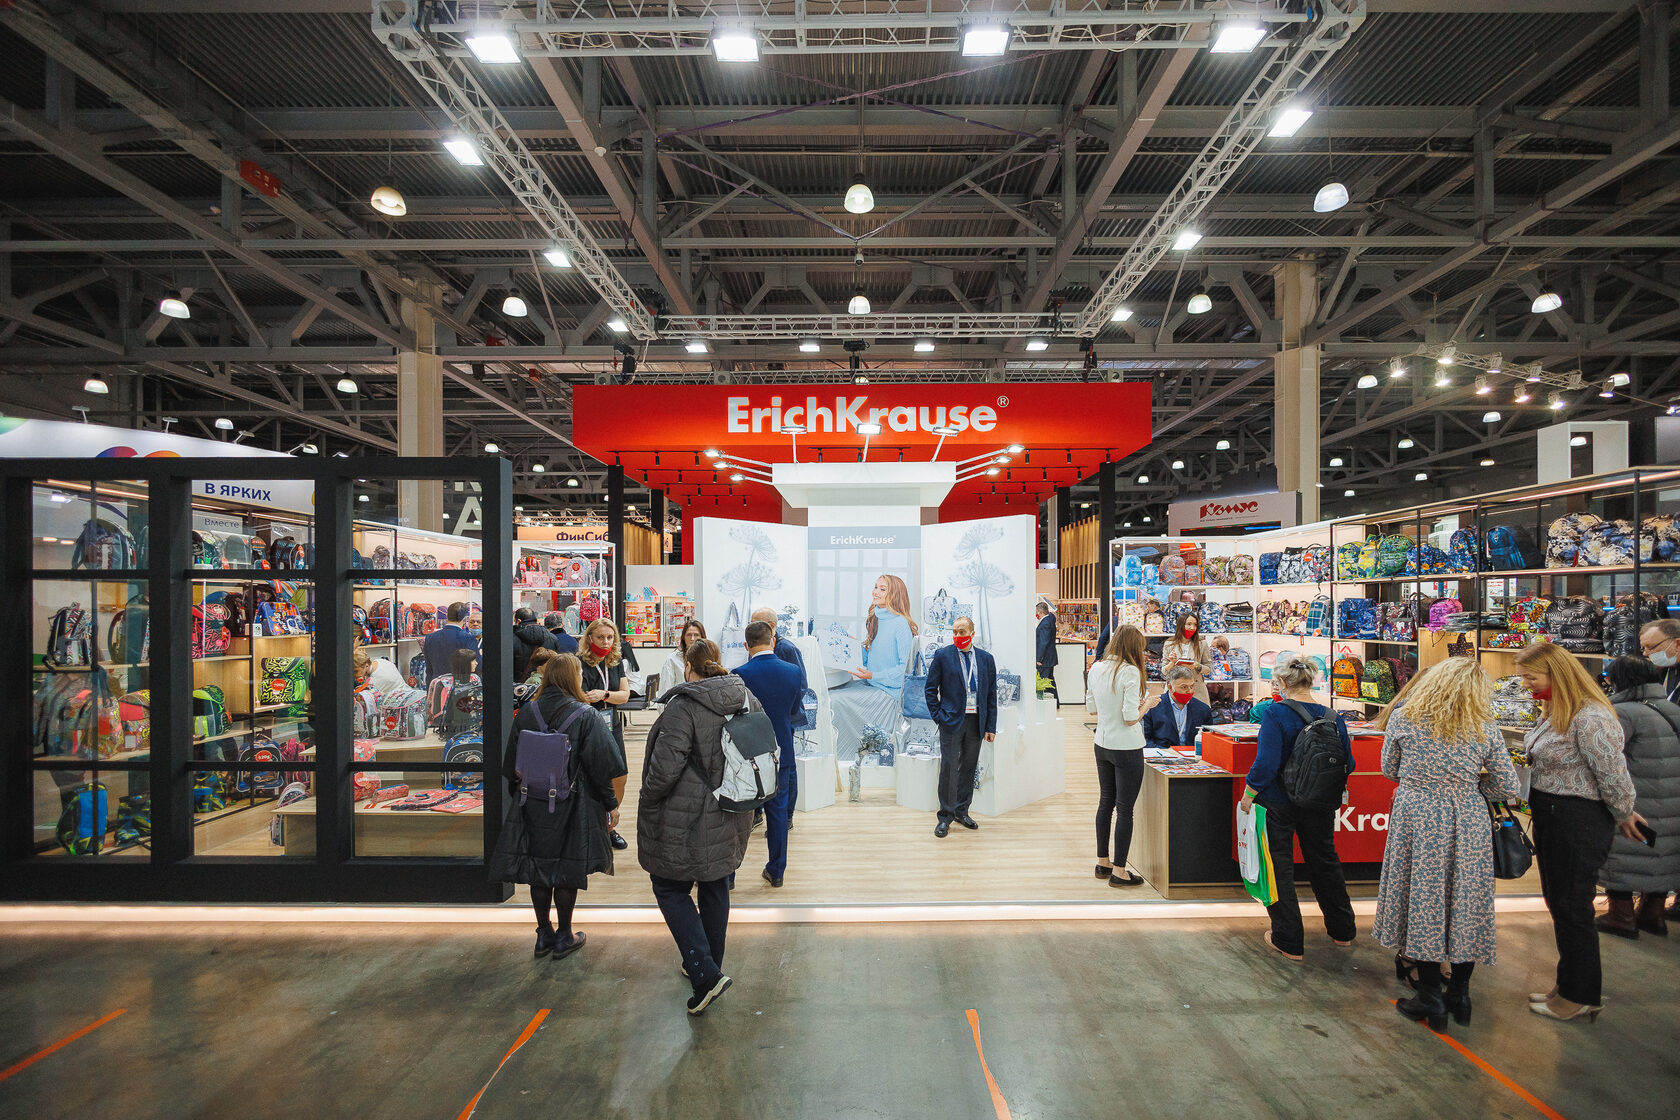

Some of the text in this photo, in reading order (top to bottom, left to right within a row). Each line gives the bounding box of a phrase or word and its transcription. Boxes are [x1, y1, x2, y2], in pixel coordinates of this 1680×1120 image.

[205, 482, 271, 501] В ЯРКИХ
[204, 517, 240, 529] Вместе
